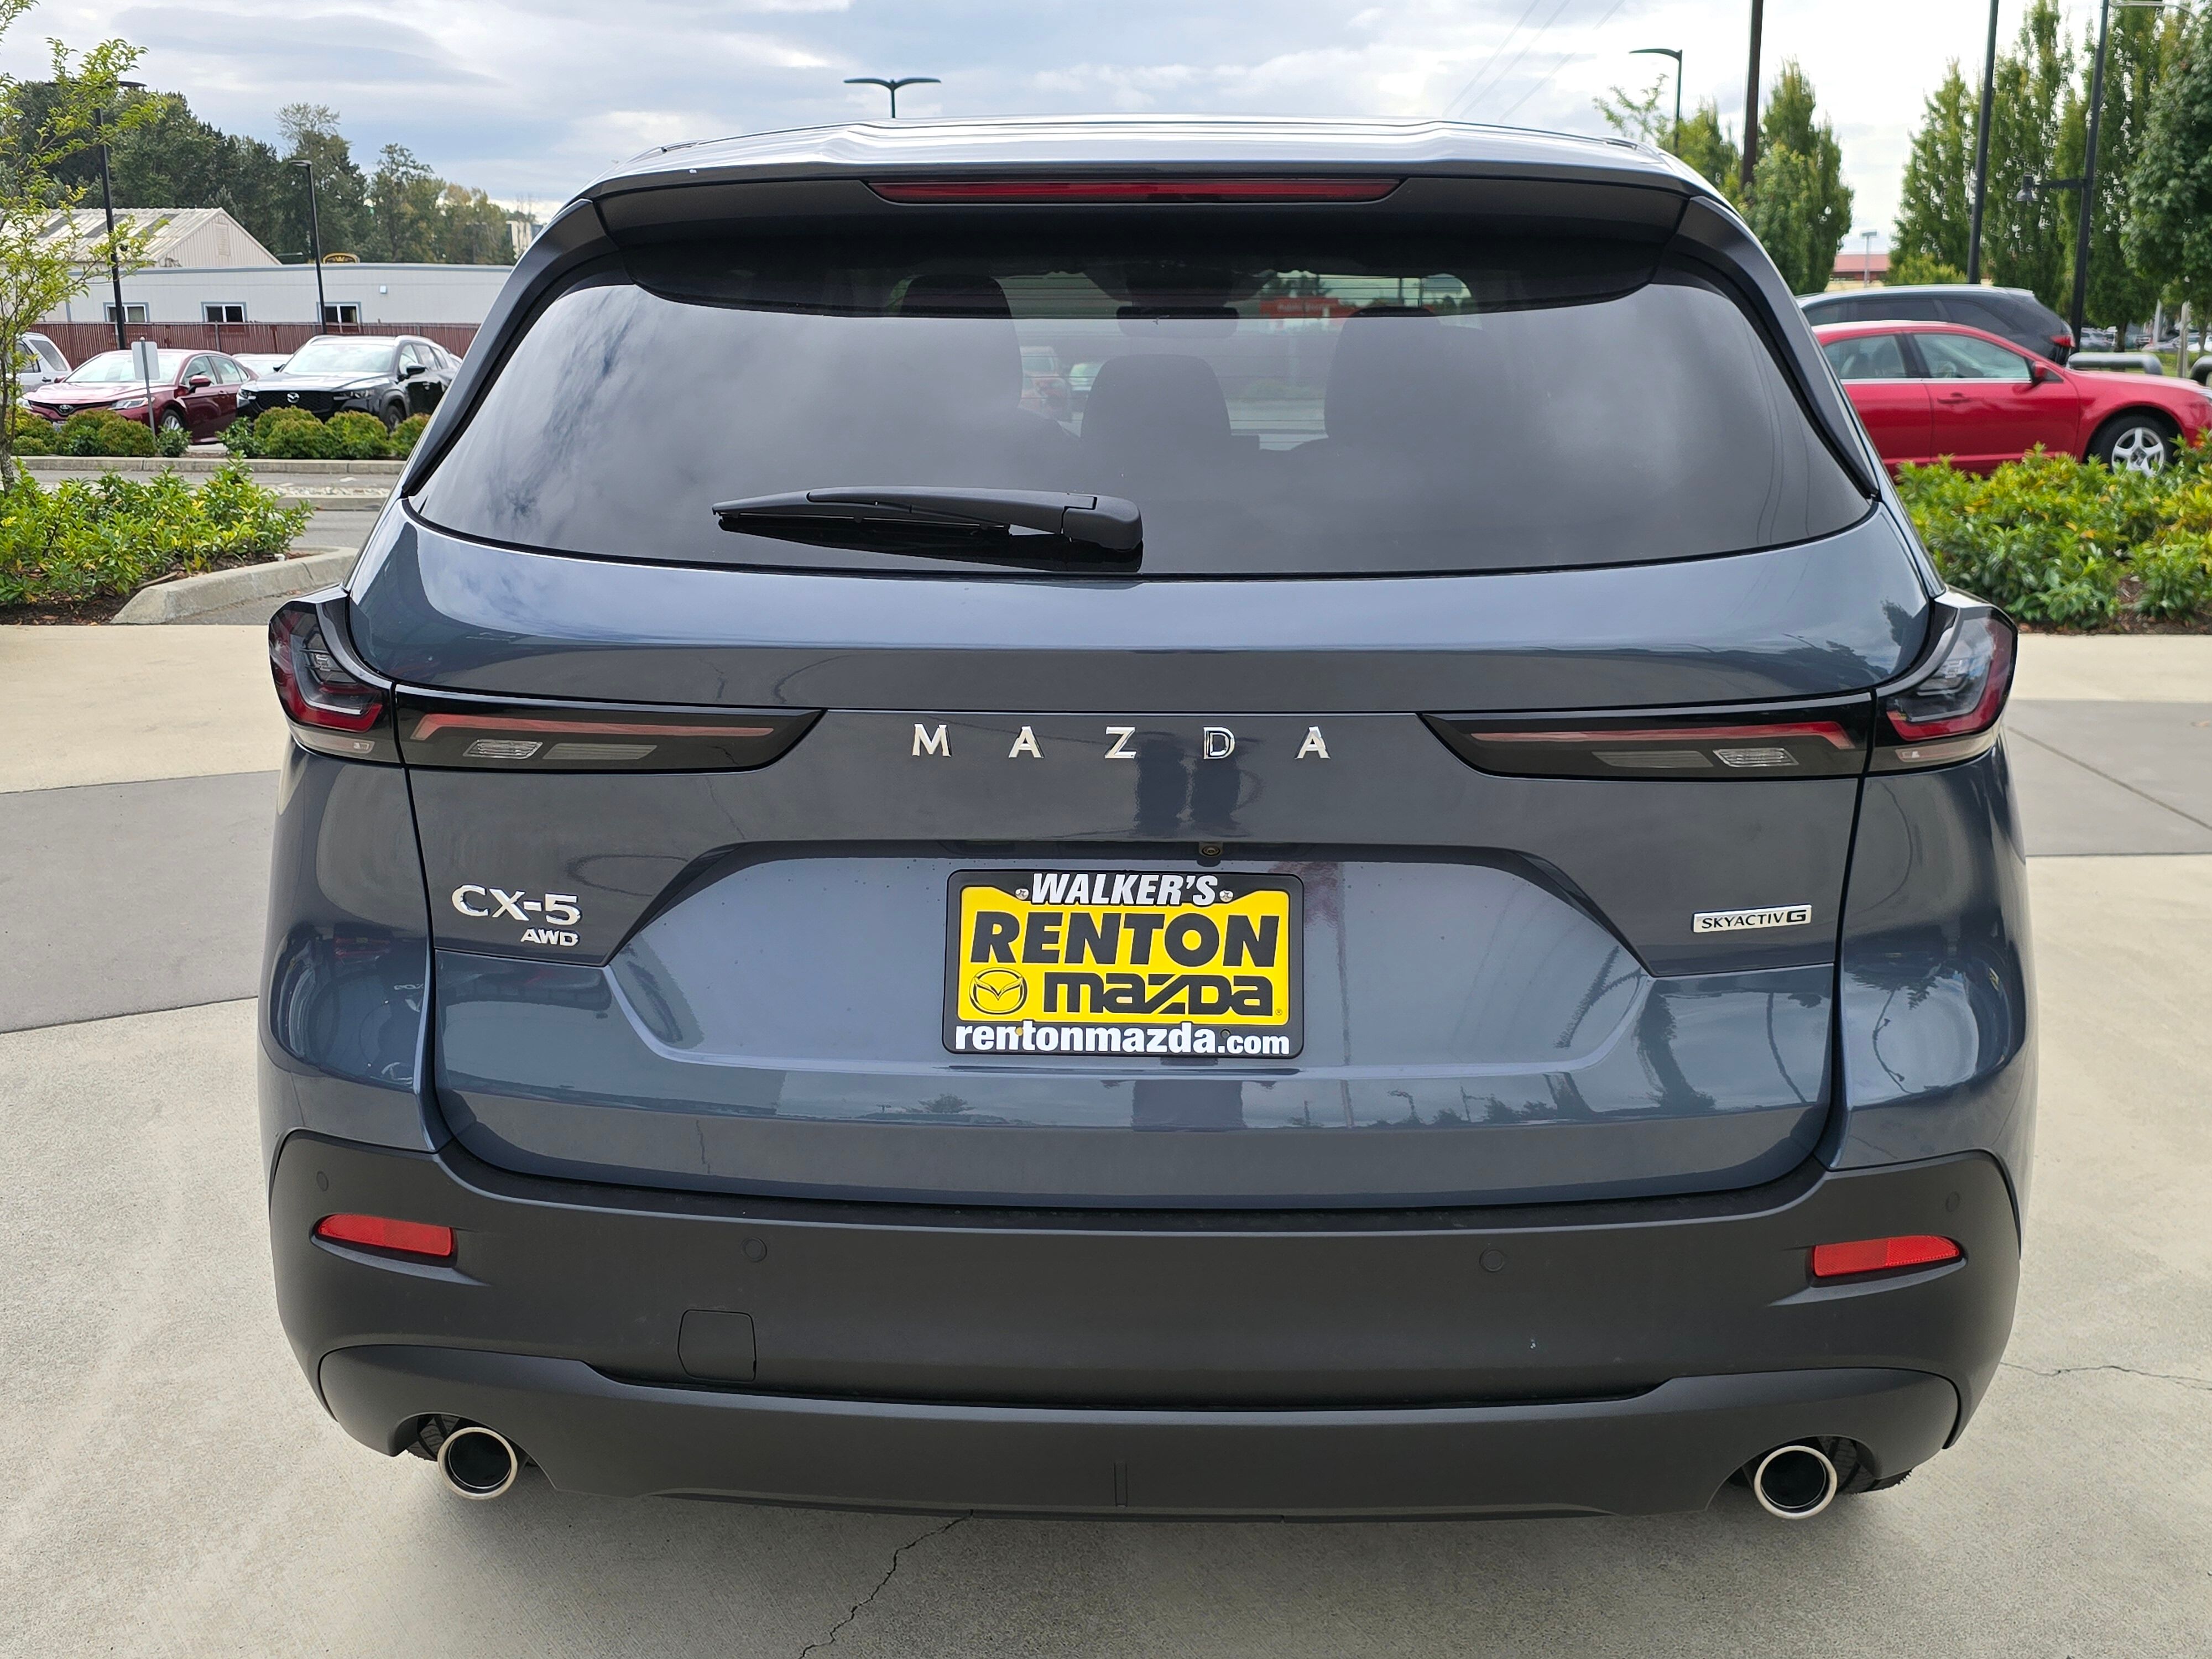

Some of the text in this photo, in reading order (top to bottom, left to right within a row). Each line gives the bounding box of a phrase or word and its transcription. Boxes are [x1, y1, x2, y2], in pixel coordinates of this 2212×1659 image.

[912, 723, 1331, 759] MAZDA
[451, 884, 581, 925] CX-5
[1031, 873, 1218, 905] WALKER'S
[520, 928, 579, 946] AWD
[970, 911, 1280, 967] RENTON
[1043, 972, 1273, 1016] mazda
[955, 1019, 1290, 1055] rentonmazda.com
